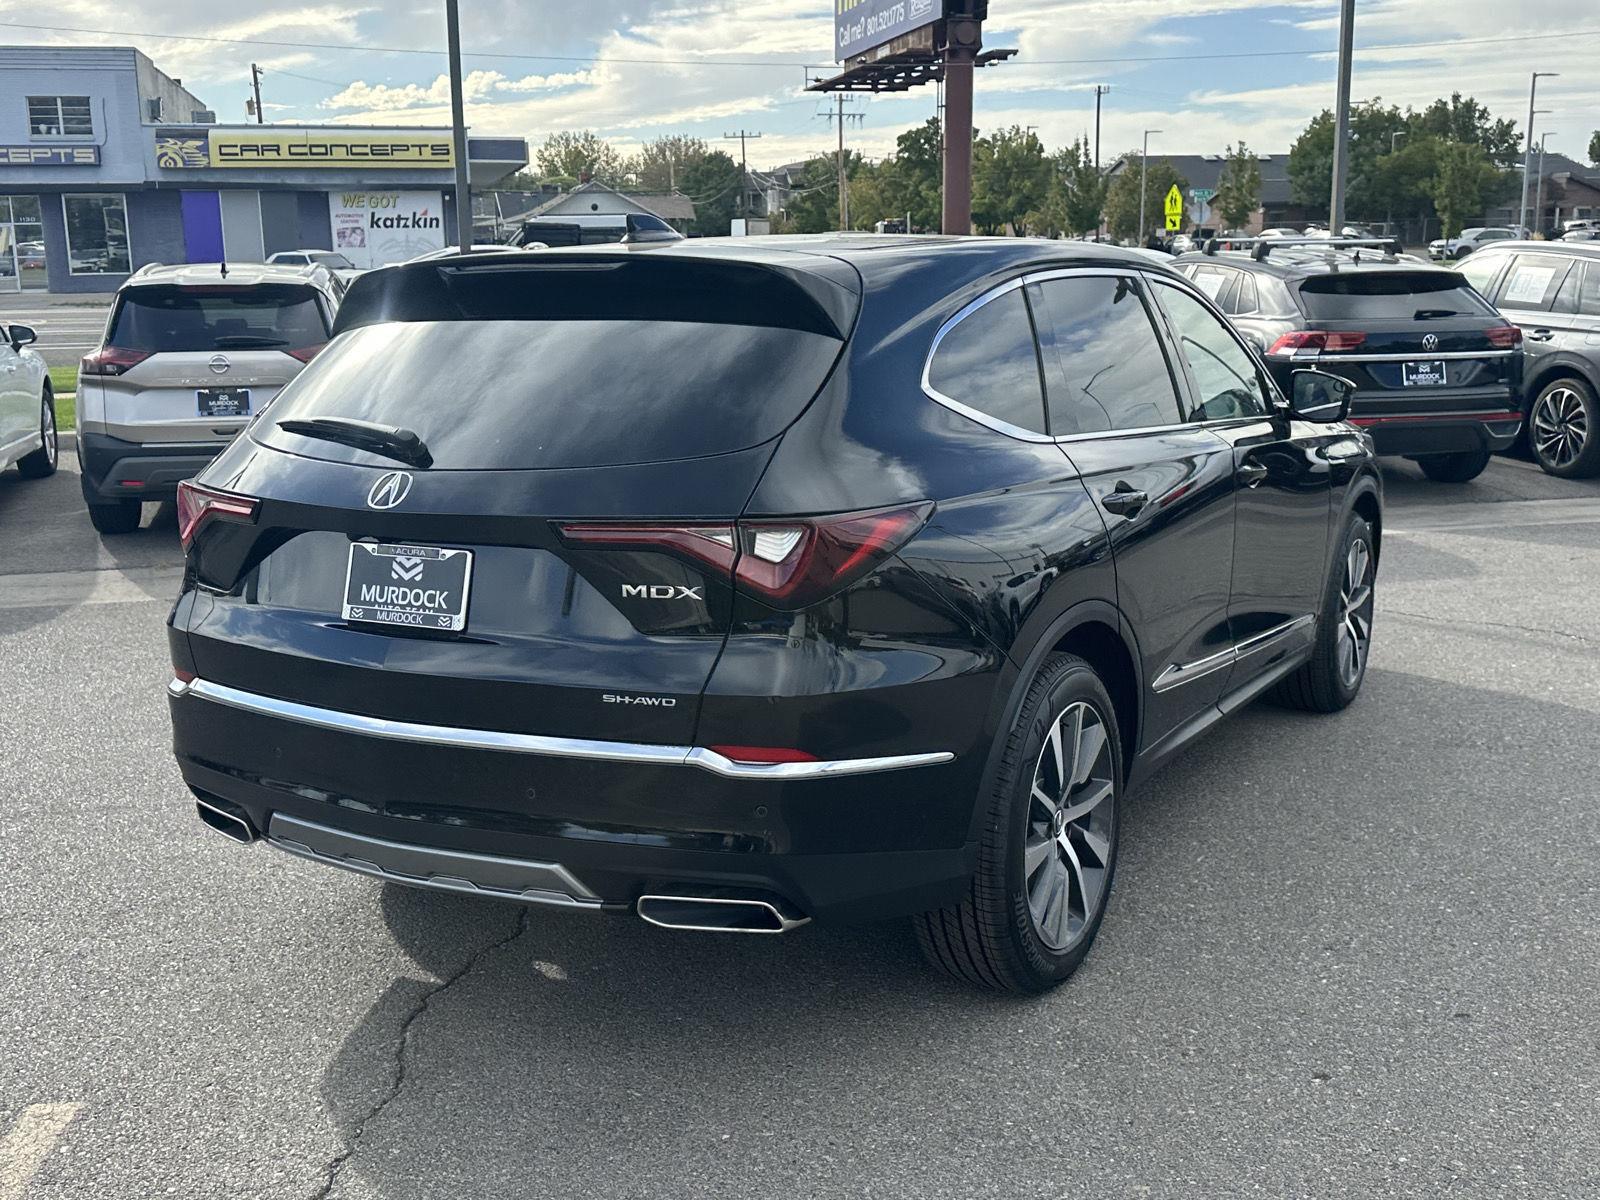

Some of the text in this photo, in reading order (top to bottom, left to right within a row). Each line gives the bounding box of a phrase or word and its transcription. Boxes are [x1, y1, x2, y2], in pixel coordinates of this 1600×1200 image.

[840, 24, 850, 47] Call
[851, 16, 865, 41] me?
[218, 143, 451, 157] CAR CONCEPTS
[342, 194, 399, 209] WE GOT
[370, 209, 440, 229] katzkin
[395, 547, 426, 557] ACURA
[361, 584, 449, 609] MURDOCK
[621, 584, 703, 600] MDX
[376, 610, 424, 625] MURDOCK
[602, 694, 677, 707] SH-AWD
